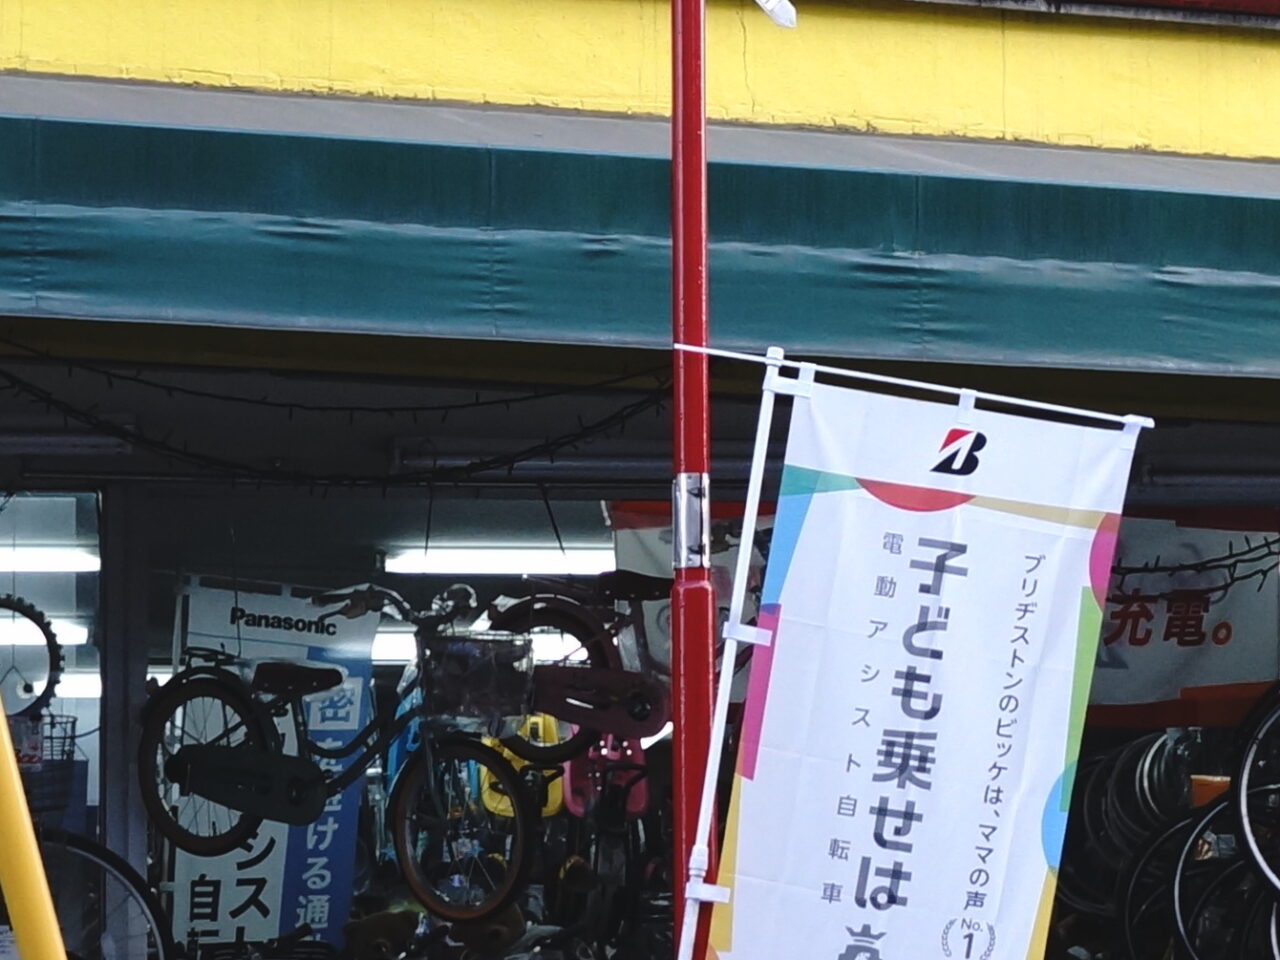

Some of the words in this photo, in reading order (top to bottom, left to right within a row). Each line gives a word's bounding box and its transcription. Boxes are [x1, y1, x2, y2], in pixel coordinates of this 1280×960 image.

[229, 606, 338, 637] Panasonic
[820, 531, 904, 904] 電動アシスト自転車
[853, 536, 969, 912] 子ども乗せは
[961, 916, 984, 932] No.
[963, 932, 974, 960] 1
